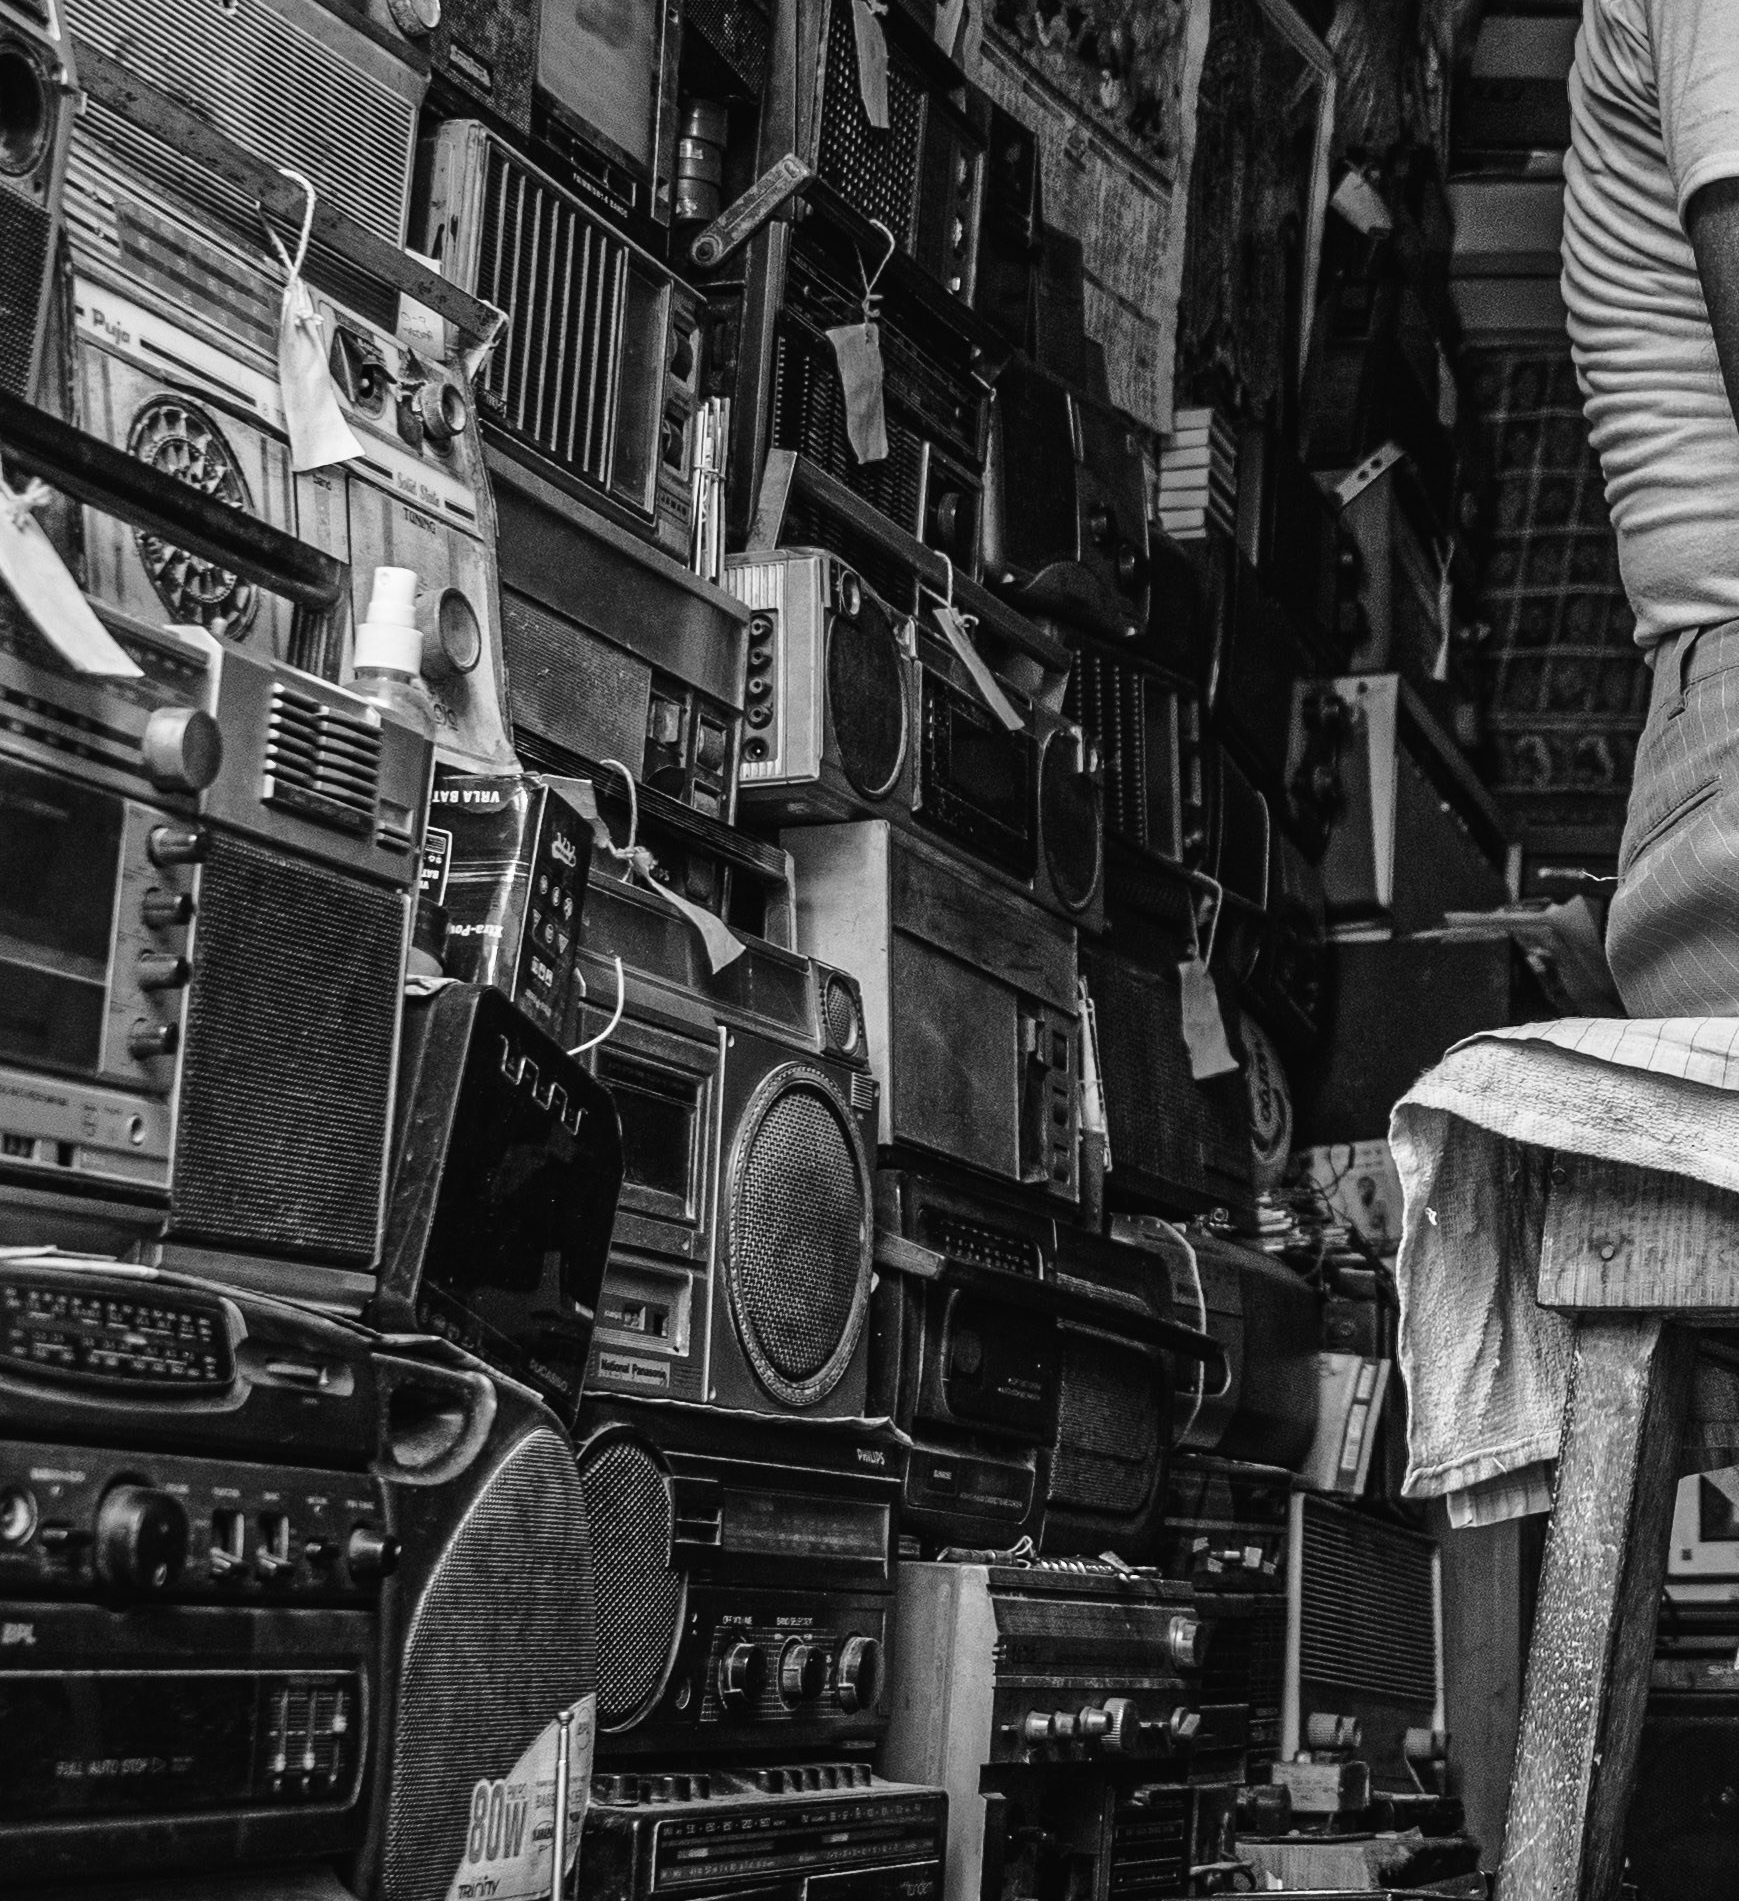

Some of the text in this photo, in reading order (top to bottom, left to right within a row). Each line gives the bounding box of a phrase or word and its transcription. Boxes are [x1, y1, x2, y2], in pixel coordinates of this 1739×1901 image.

[92, 308, 131, 346] Puja
[464, 790, 501, 804] VRLA
[87, 1757, 119, 1775] AUTO
[120, 1756, 148, 1773] STOP
[466, 1778, 528, 1865] 80W
